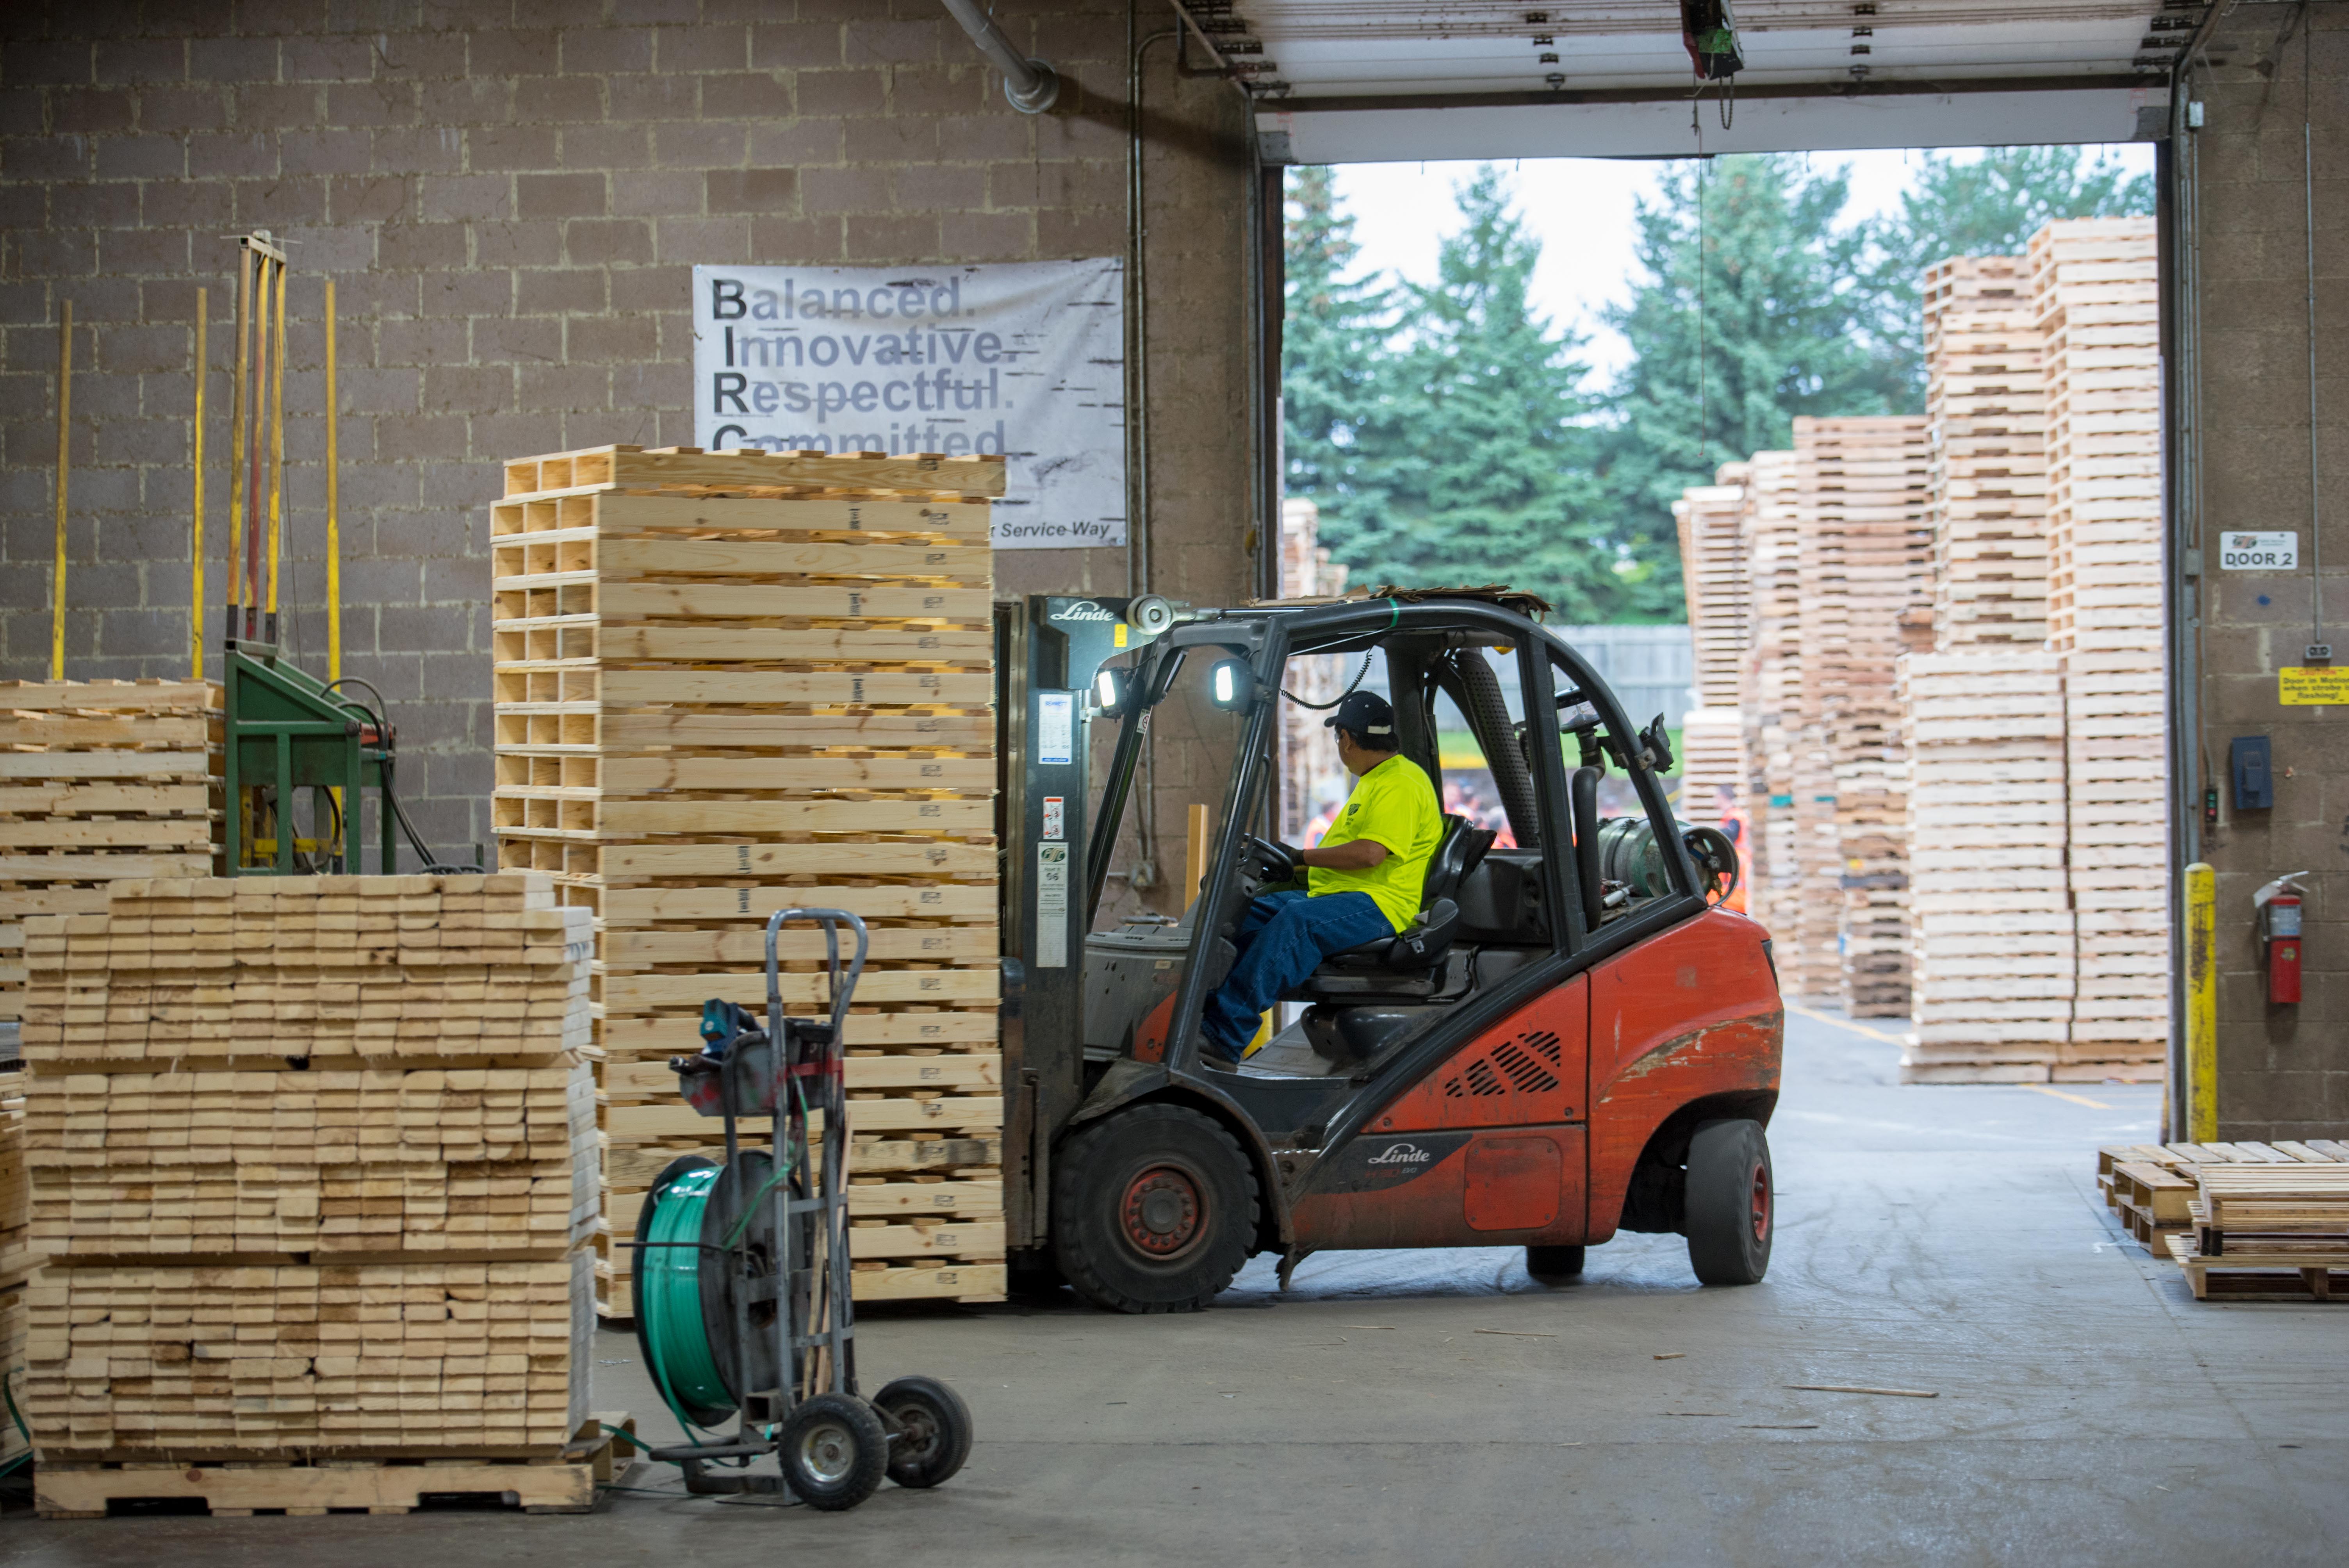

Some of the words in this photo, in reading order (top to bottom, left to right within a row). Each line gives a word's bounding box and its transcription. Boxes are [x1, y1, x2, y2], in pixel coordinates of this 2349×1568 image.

[713, 276, 975, 321] Balanced.
[725, 324, 1016, 367] Innovative.
[713, 368, 1014, 424] Respectful.
[1001, 522, 1066, 538] Service
[1073, 521, 1110, 539] Way
[2225, 553, 2276, 565] DOOR
[2282, 552, 2292, 566] 2
[1050, 601, 1114, 622] Linde
[1368, 1143, 1430, 1164] Linde
